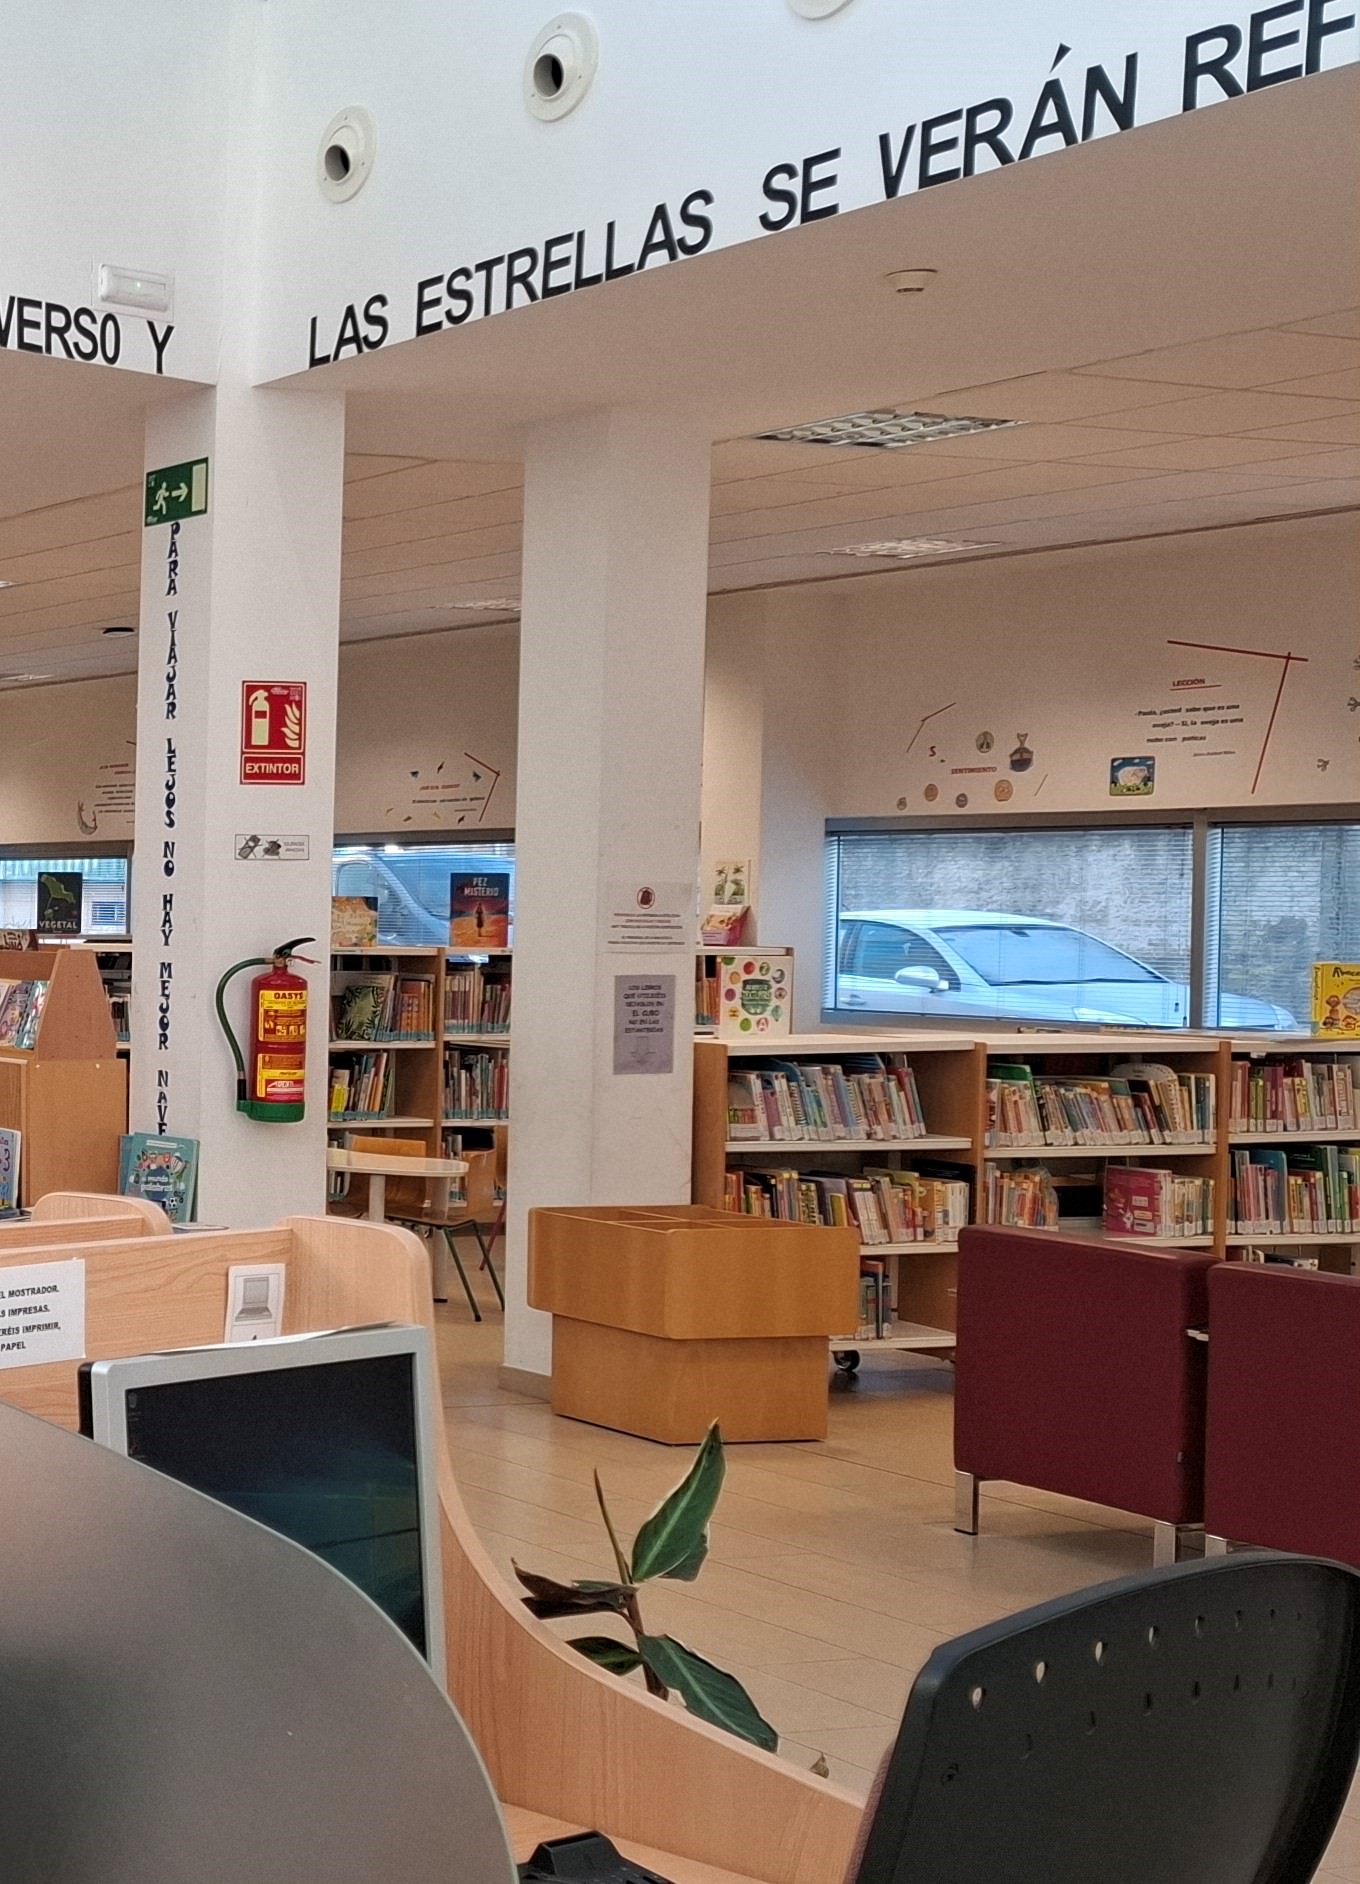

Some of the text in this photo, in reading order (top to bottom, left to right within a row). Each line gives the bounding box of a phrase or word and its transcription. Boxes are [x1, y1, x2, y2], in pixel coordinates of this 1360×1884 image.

[308, 0, 1357, 371] LAS ESTRELLAS SE VERÁN REF
[146, 320, 174, 375] Y
[165, 521, 181, 596] PARA
[165, 610, 179, 720] VIAJAR
[164, 738, 177, 829] LEJOS
[245, 762, 299, 775] EXTINTOR
[162, 841, 176, 877] NO
[39, 920, 78, 930] VEGETAL
[160, 894, 175, 946] HAY
[159, 962, 173, 1050] MEJOR
[8, 1284, 59, 1297] MOSTRADOR.
[8, 1304, 50, 1316] IMPRESAS.
[0, 1341, 26, 1351] PAPEL
